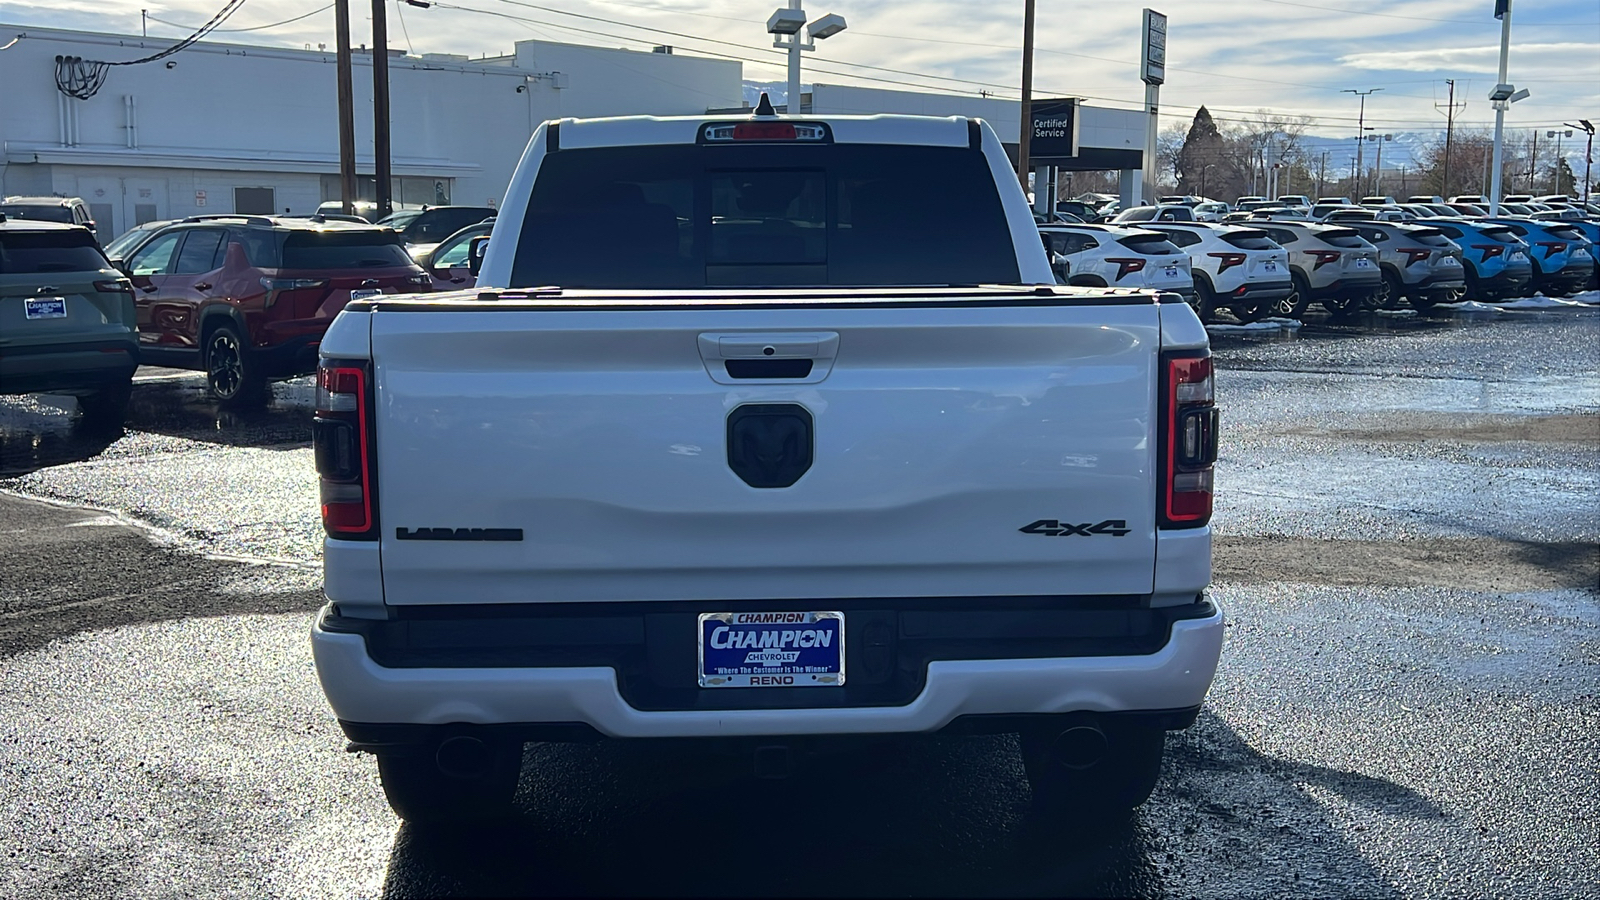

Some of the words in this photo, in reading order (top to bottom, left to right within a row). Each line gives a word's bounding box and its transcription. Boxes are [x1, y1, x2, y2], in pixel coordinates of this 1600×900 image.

[1034, 118, 1068, 128] Certified
[1035, 128, 1065, 138] Service
[737, 613, 805, 624] CHAMPION
[710, 626, 833, 649] CHAMPION
[747, 653, 796, 661] CHEVROLET
[753, 666, 784, 674] Customer
[750, 676, 794, 685] RENO
